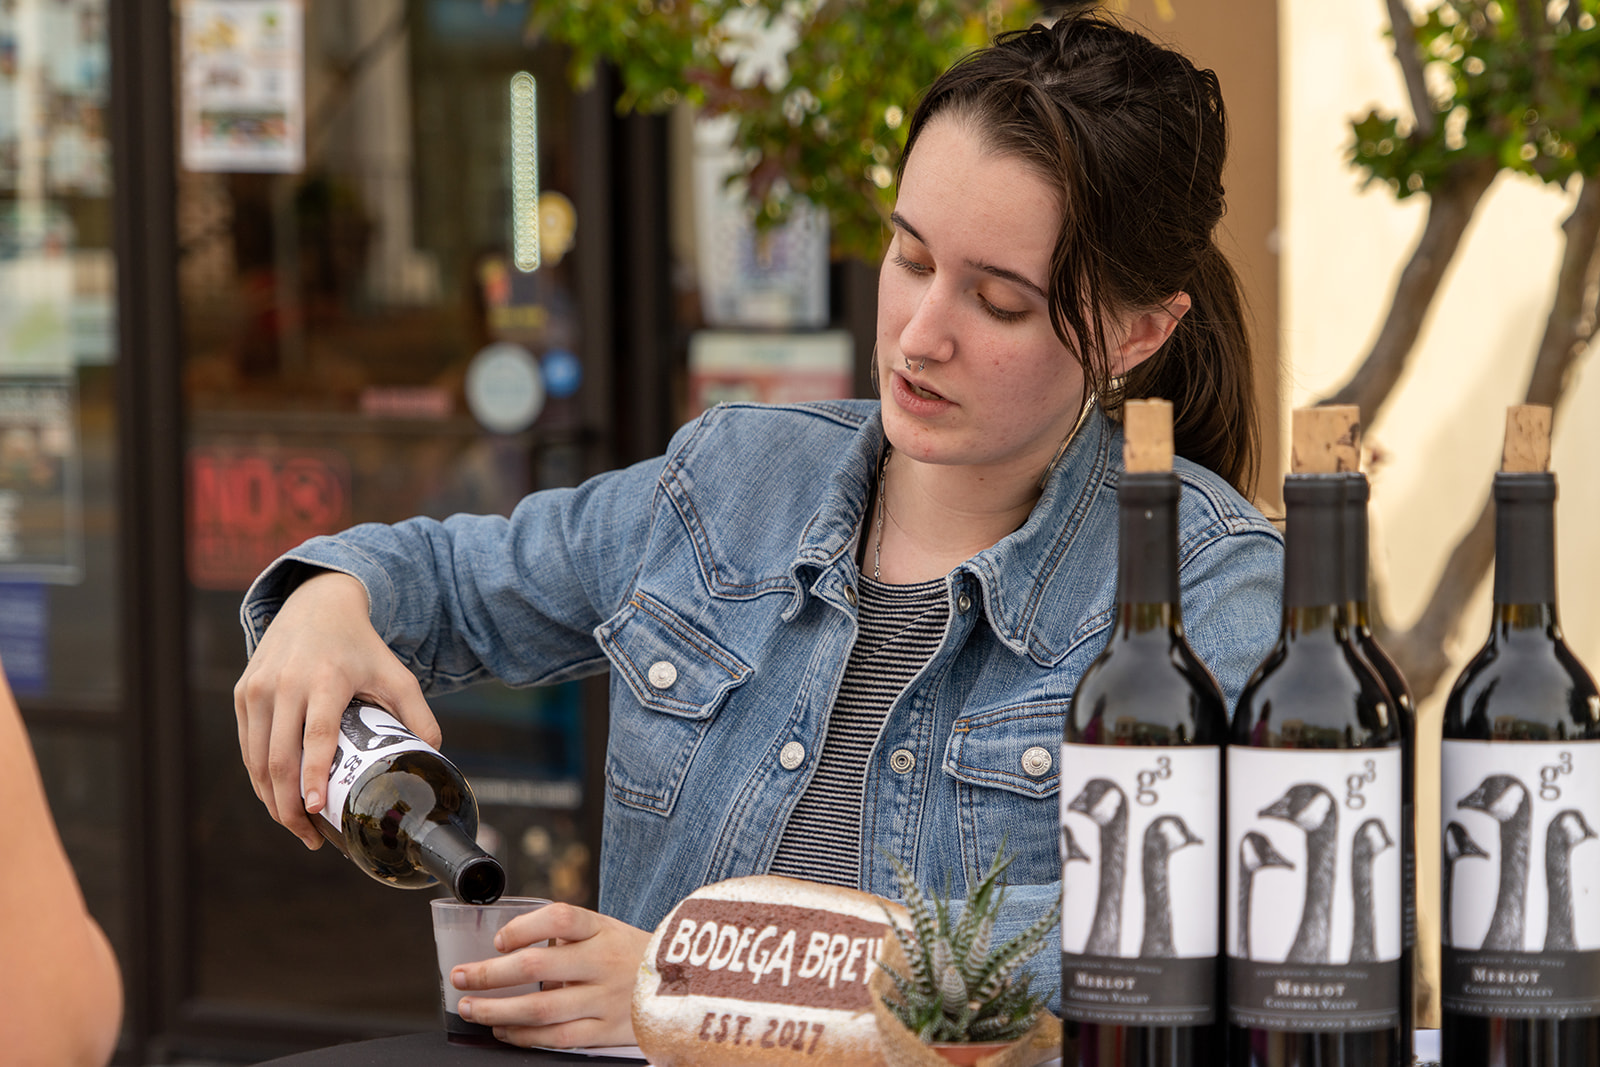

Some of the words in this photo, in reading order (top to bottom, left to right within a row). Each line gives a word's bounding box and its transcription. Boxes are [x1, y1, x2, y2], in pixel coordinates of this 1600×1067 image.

[665, 919, 797, 987] BODEGA
[1075, 972, 1136, 990] MERLOT
[1473, 967, 1540, 984] MERLOT
[1275, 980, 1345, 997] MERLOT
[1464, 985, 1513, 996] COLUMBIA
[1516, 986, 1554, 997] VALLEY
[699, 1012, 754, 1047] EST.
[760, 1019, 825, 1054] 2017
